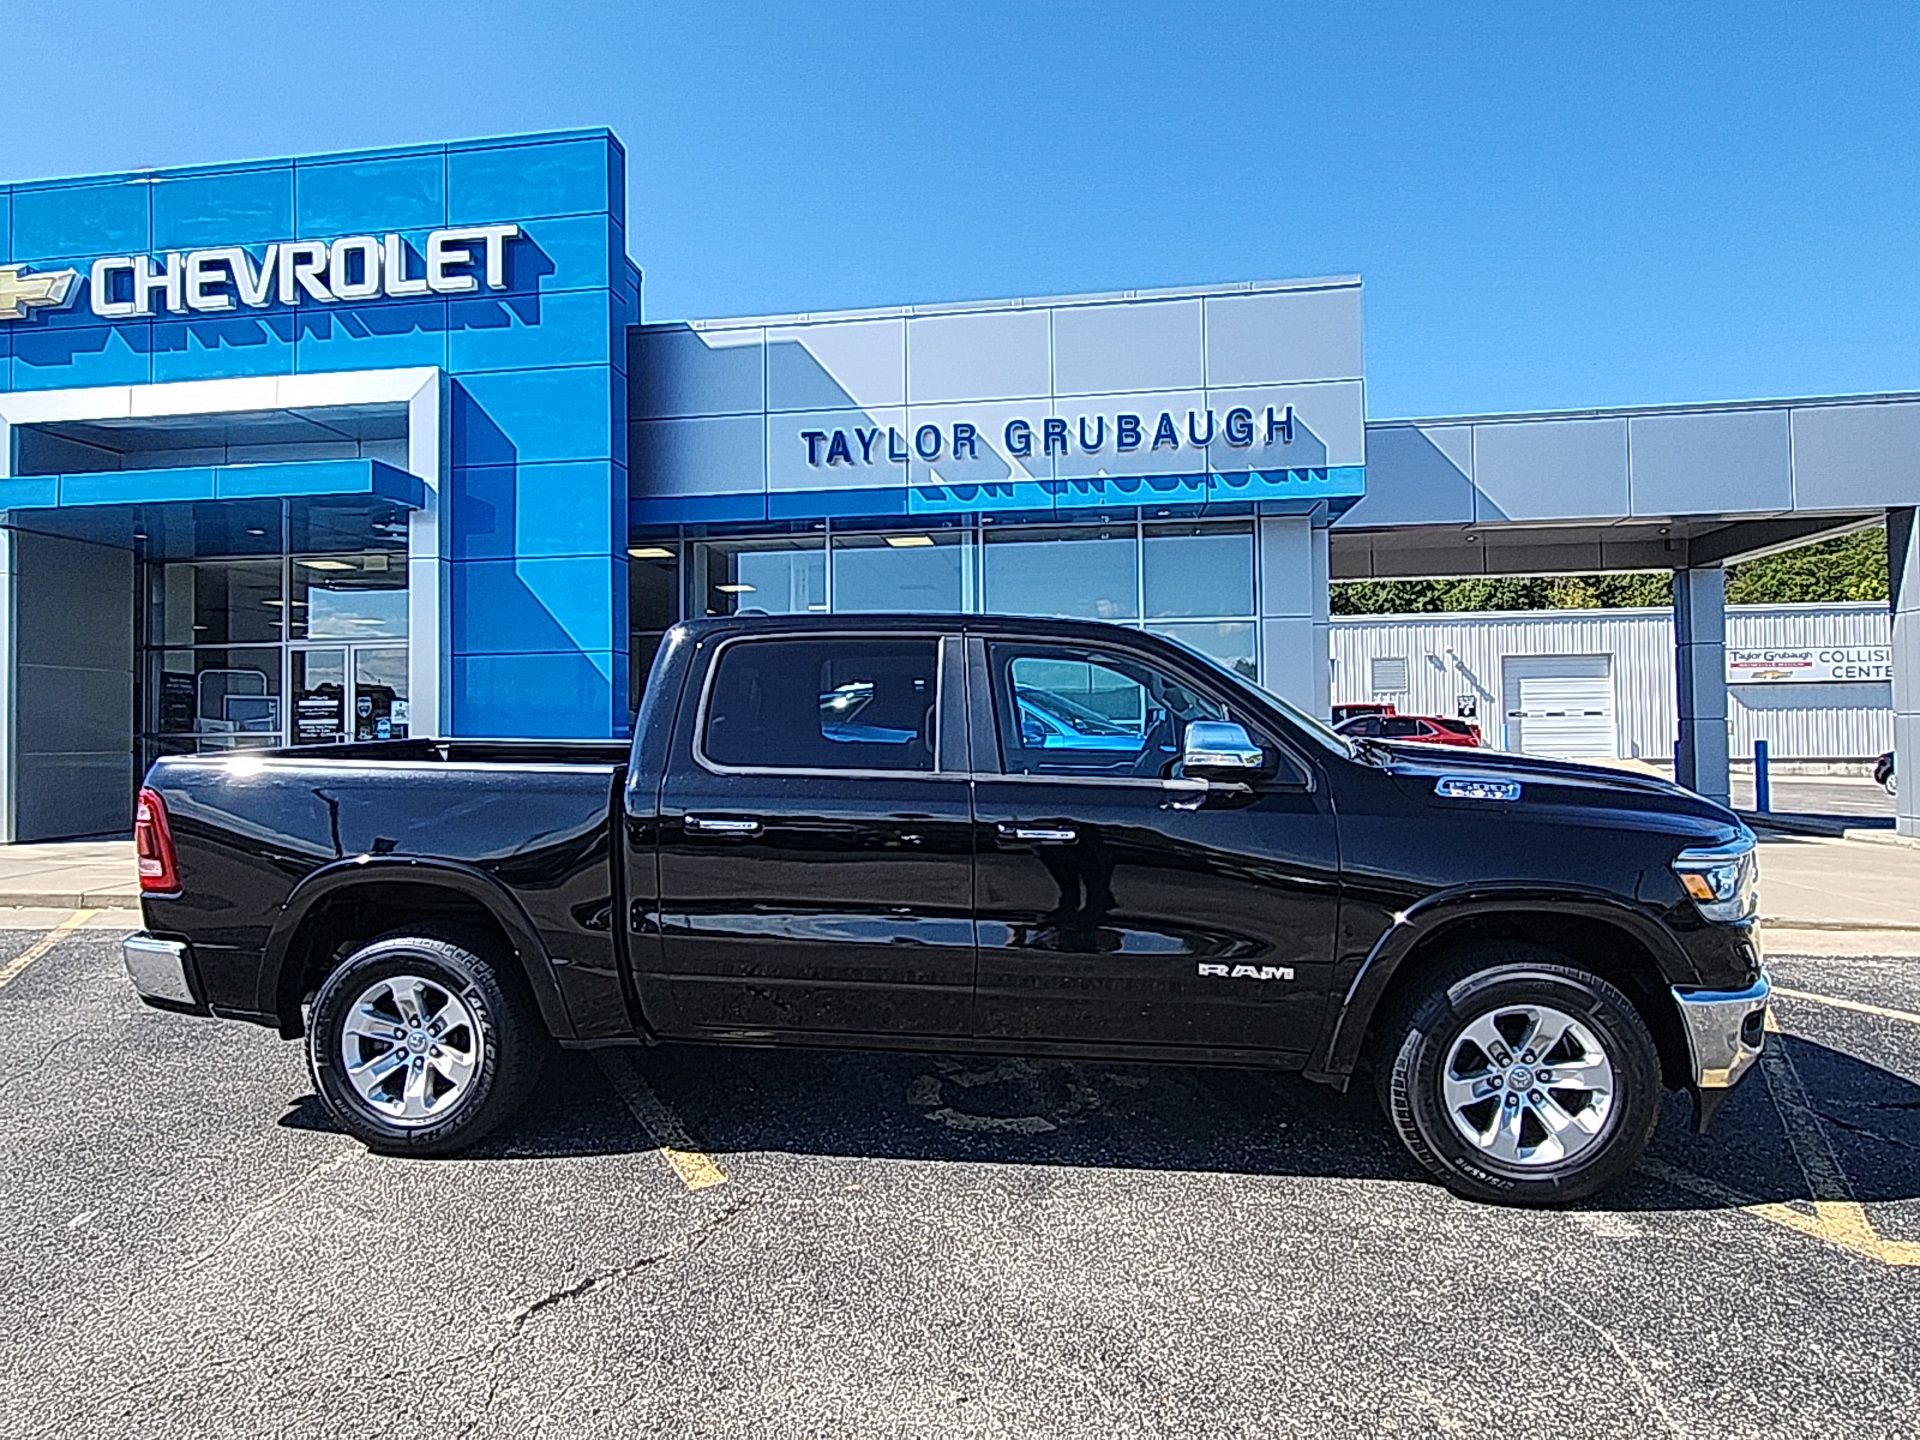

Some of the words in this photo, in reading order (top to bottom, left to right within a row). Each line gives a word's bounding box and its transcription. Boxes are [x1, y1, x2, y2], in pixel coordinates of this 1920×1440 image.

[90, 224, 522, 318] CHEVROLET
[800, 422, 977, 466] TAYLOR
[1003, 405, 1295, 457] GRUBAUGH
[1729, 651, 1762, 661] Taylor
[1764, 651, 1813, 661] Grubaugh
[1819, 650, 1890, 663] COLLISI
[1832, 665, 1893, 678] CENTE
[1198, 963, 1294, 980] RAM
